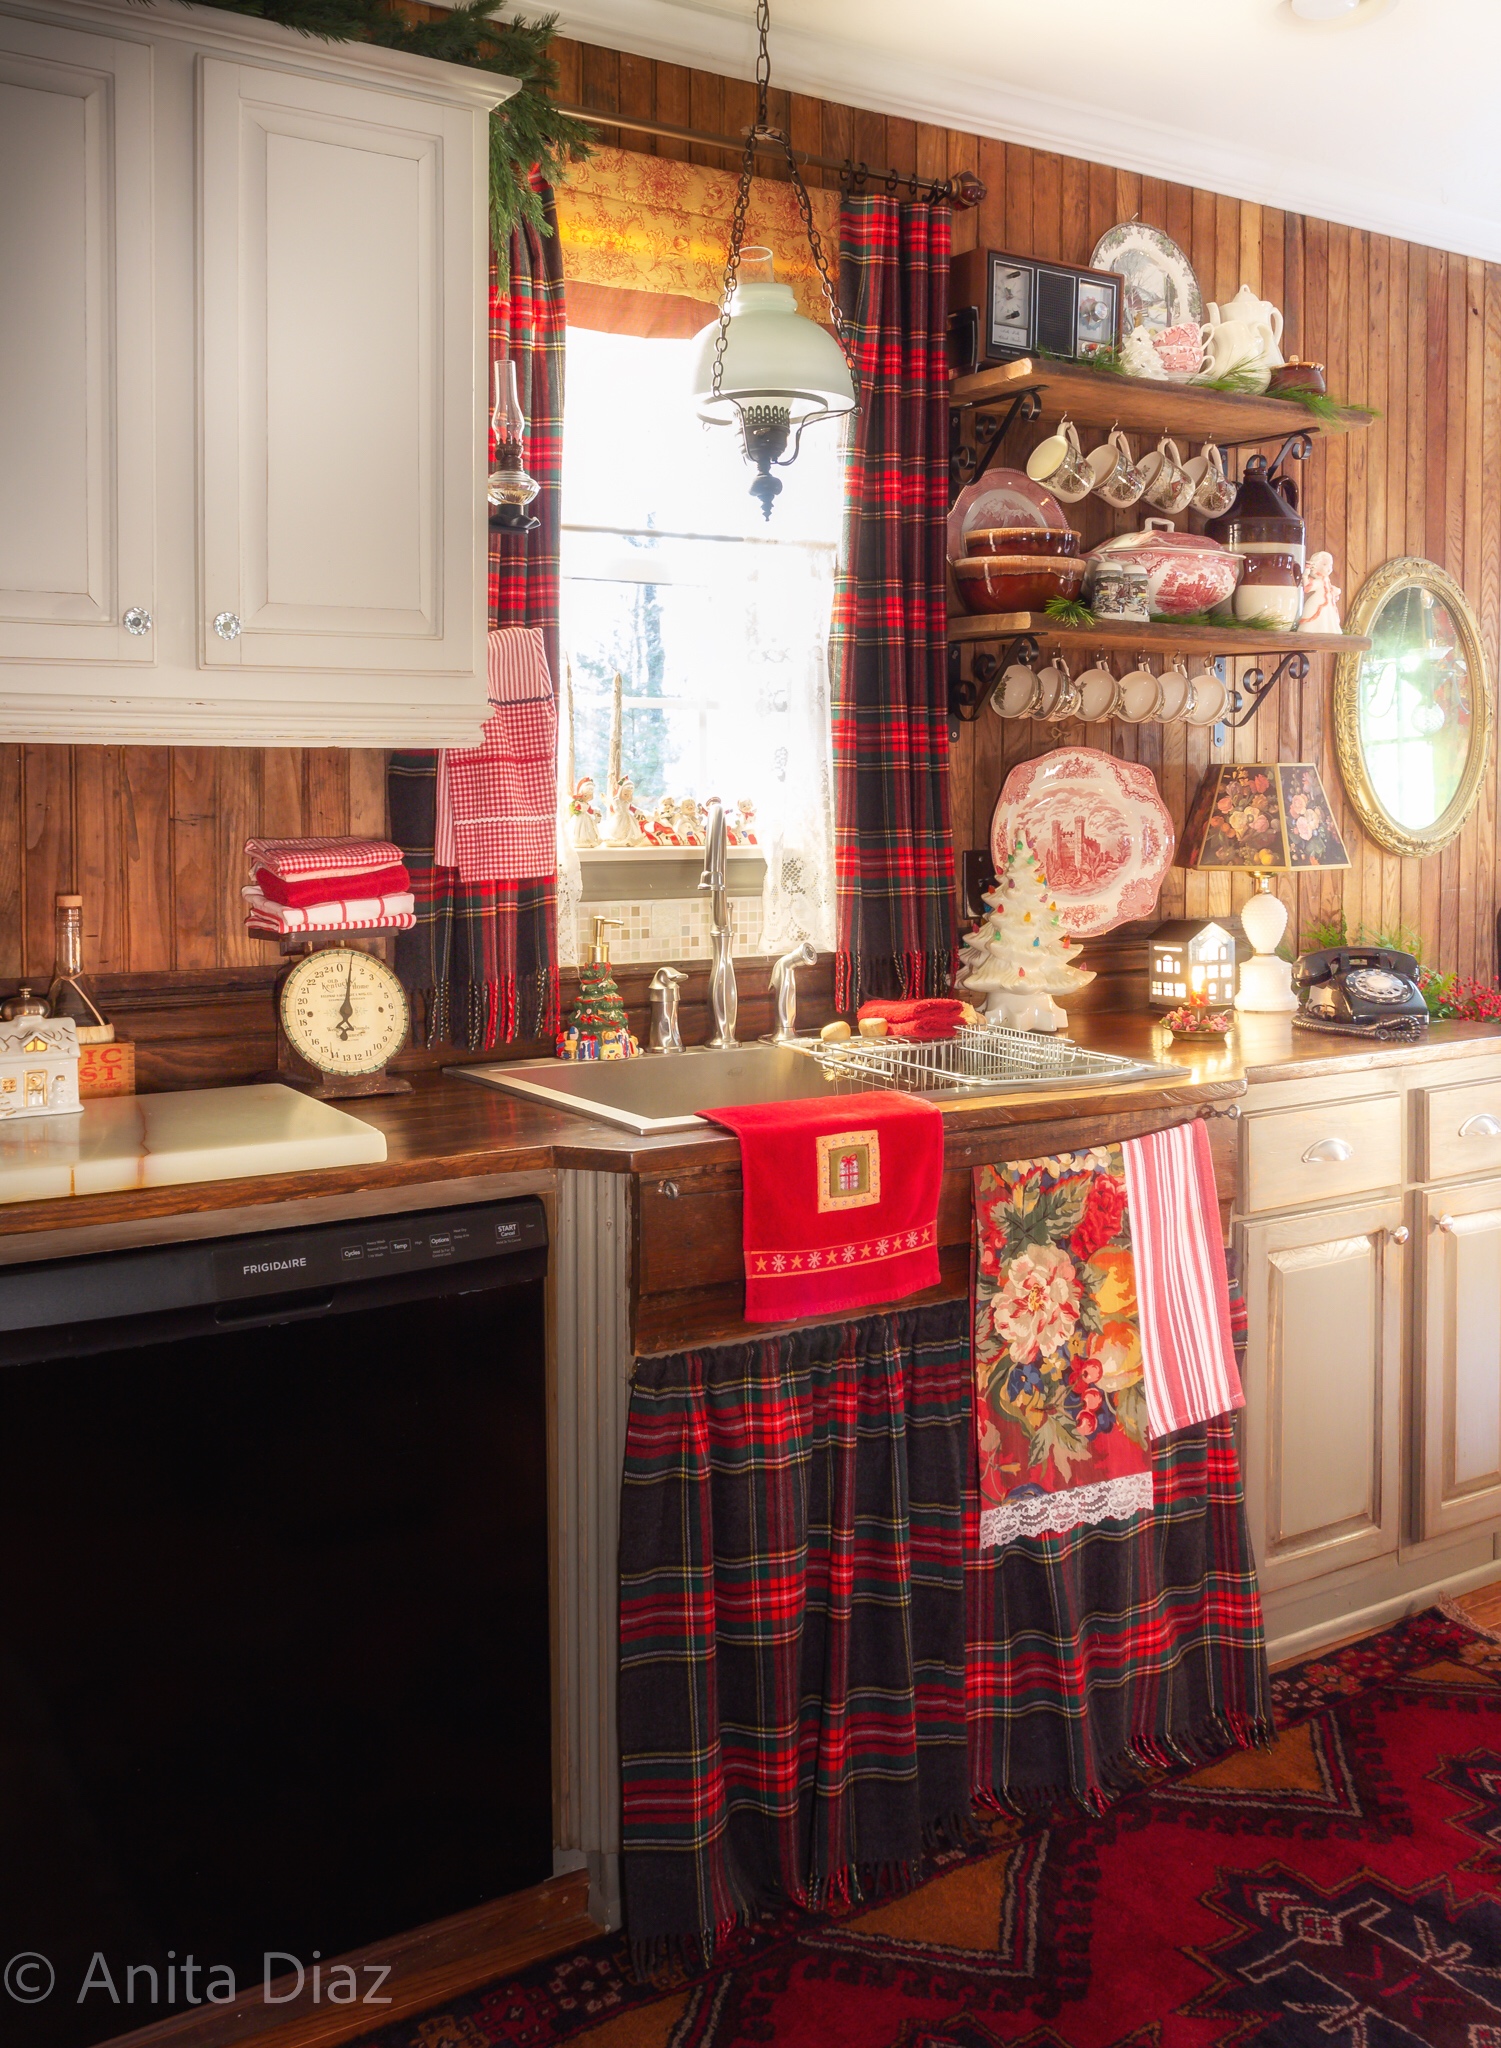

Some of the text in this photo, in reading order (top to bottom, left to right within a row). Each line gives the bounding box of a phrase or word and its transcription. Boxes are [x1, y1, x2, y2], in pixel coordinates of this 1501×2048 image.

[336, 963, 344, 973] 0
[314, 971, 325, 979] 23
[368, 973, 375, 981] 3
[297, 1008, 306, 1016] 19
[299, 1019, 308, 1027] 18
[304, 1029, 313, 1037] 17
[311, 1038, 320, 1046] 16
[382, 1035, 388, 1043] 9
[319, 1046, 329, 1054] 15
[372, 1042, 382, 1050] 10
[78, 1048, 122, 1065] IC
[331, 1051, 339, 1059] 14
[354, 1053, 363, 1061] 12
[365, 1049, 372, 1057] 11
[342, 1053, 351, 1062] 13
[79, 1065, 122, 1082] ST
[498, 1223, 517, 1232] START
[431, 1237, 450, 1245] Options
[243, 1257, 307, 1275] FRIGIDAIRE
